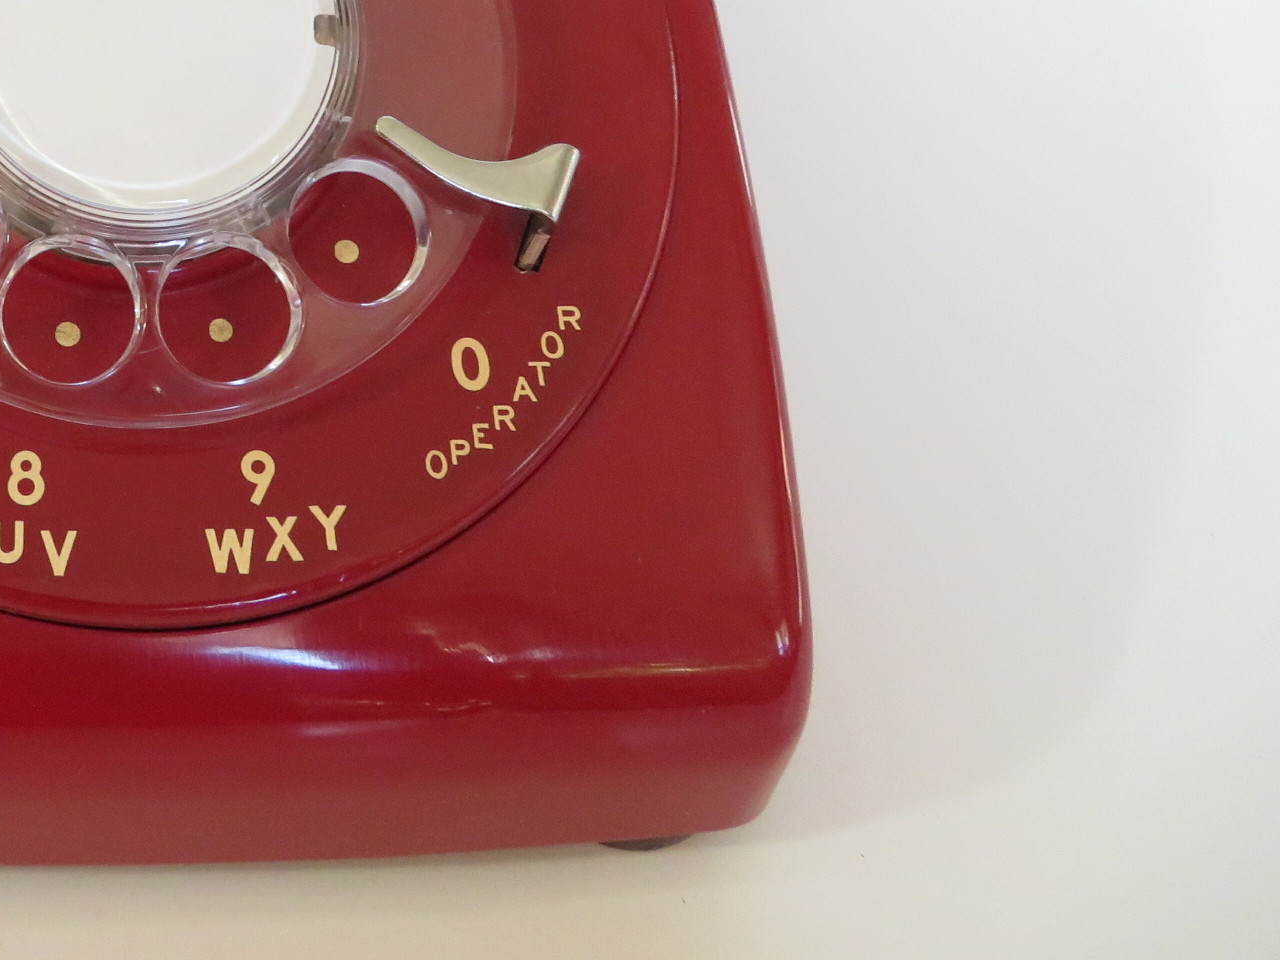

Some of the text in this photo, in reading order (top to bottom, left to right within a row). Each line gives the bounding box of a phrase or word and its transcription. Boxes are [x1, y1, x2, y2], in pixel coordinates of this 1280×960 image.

[425, 305, 581, 481] OPERATOR
[7, 450, 45, 506] 8
[240, 449, 276, 506] 9
[204, 505, 347, 575] WXY
